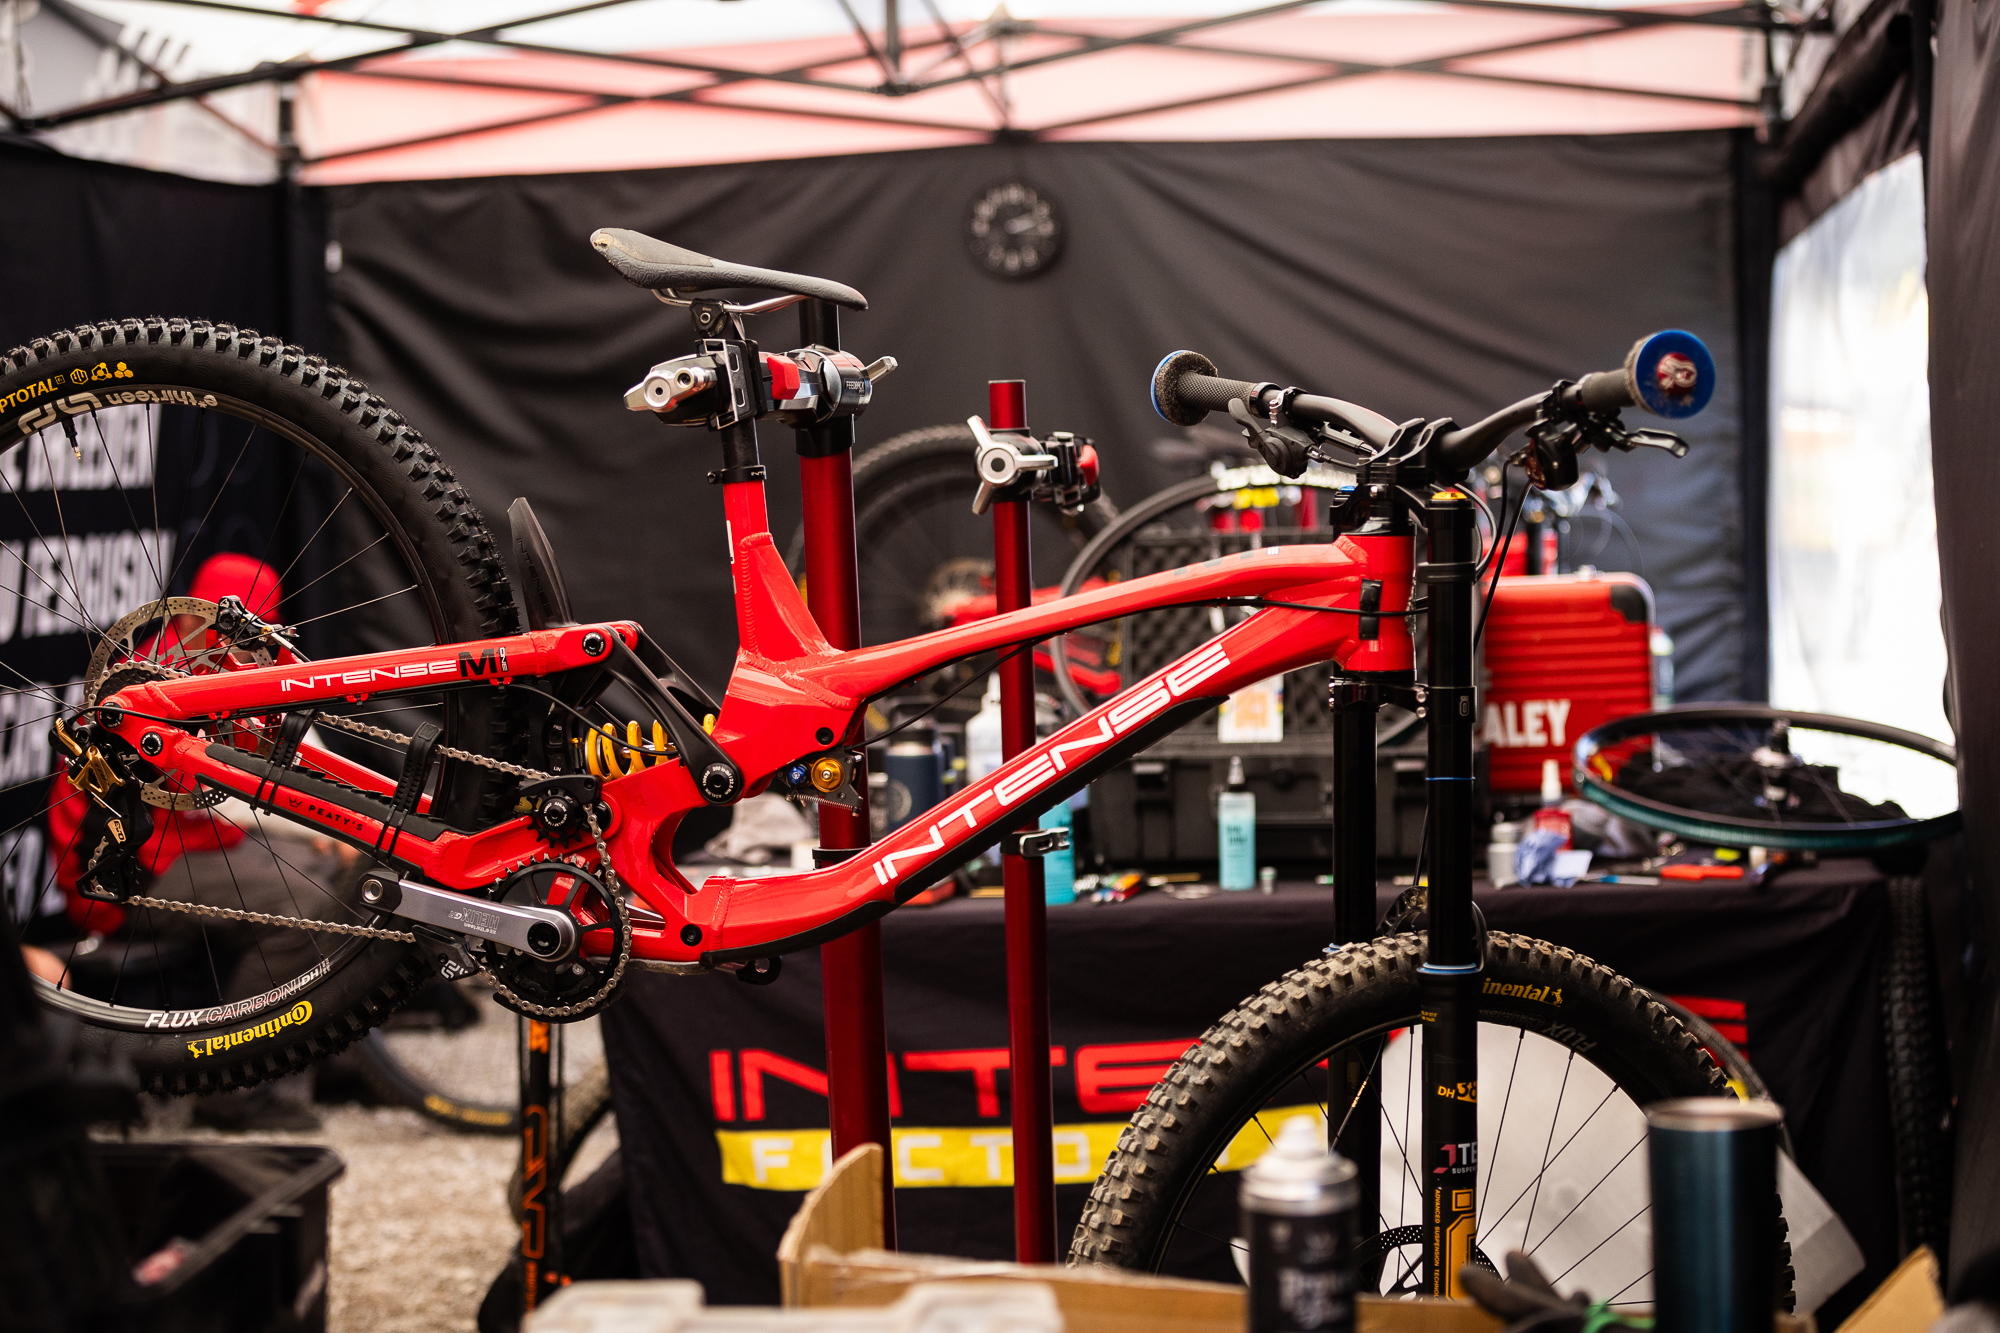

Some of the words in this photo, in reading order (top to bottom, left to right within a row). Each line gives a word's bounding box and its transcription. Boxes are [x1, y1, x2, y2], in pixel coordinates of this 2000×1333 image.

[280, 659, 458, 692] INTENSE
[872, 642, 1231, 886] INTENSE
[308, 803, 364, 832] PEATY'S
[145, 1010, 203, 1029] FLUX
[205, 980, 299, 1025] CARBON
[205, 1000, 313, 1056] Continental
[1437, 1085, 1456, 1099] DH
[1434, 1188, 1442, 1225] ADVANCED
[1433, 1226, 1441, 1267] SUSPENSION
